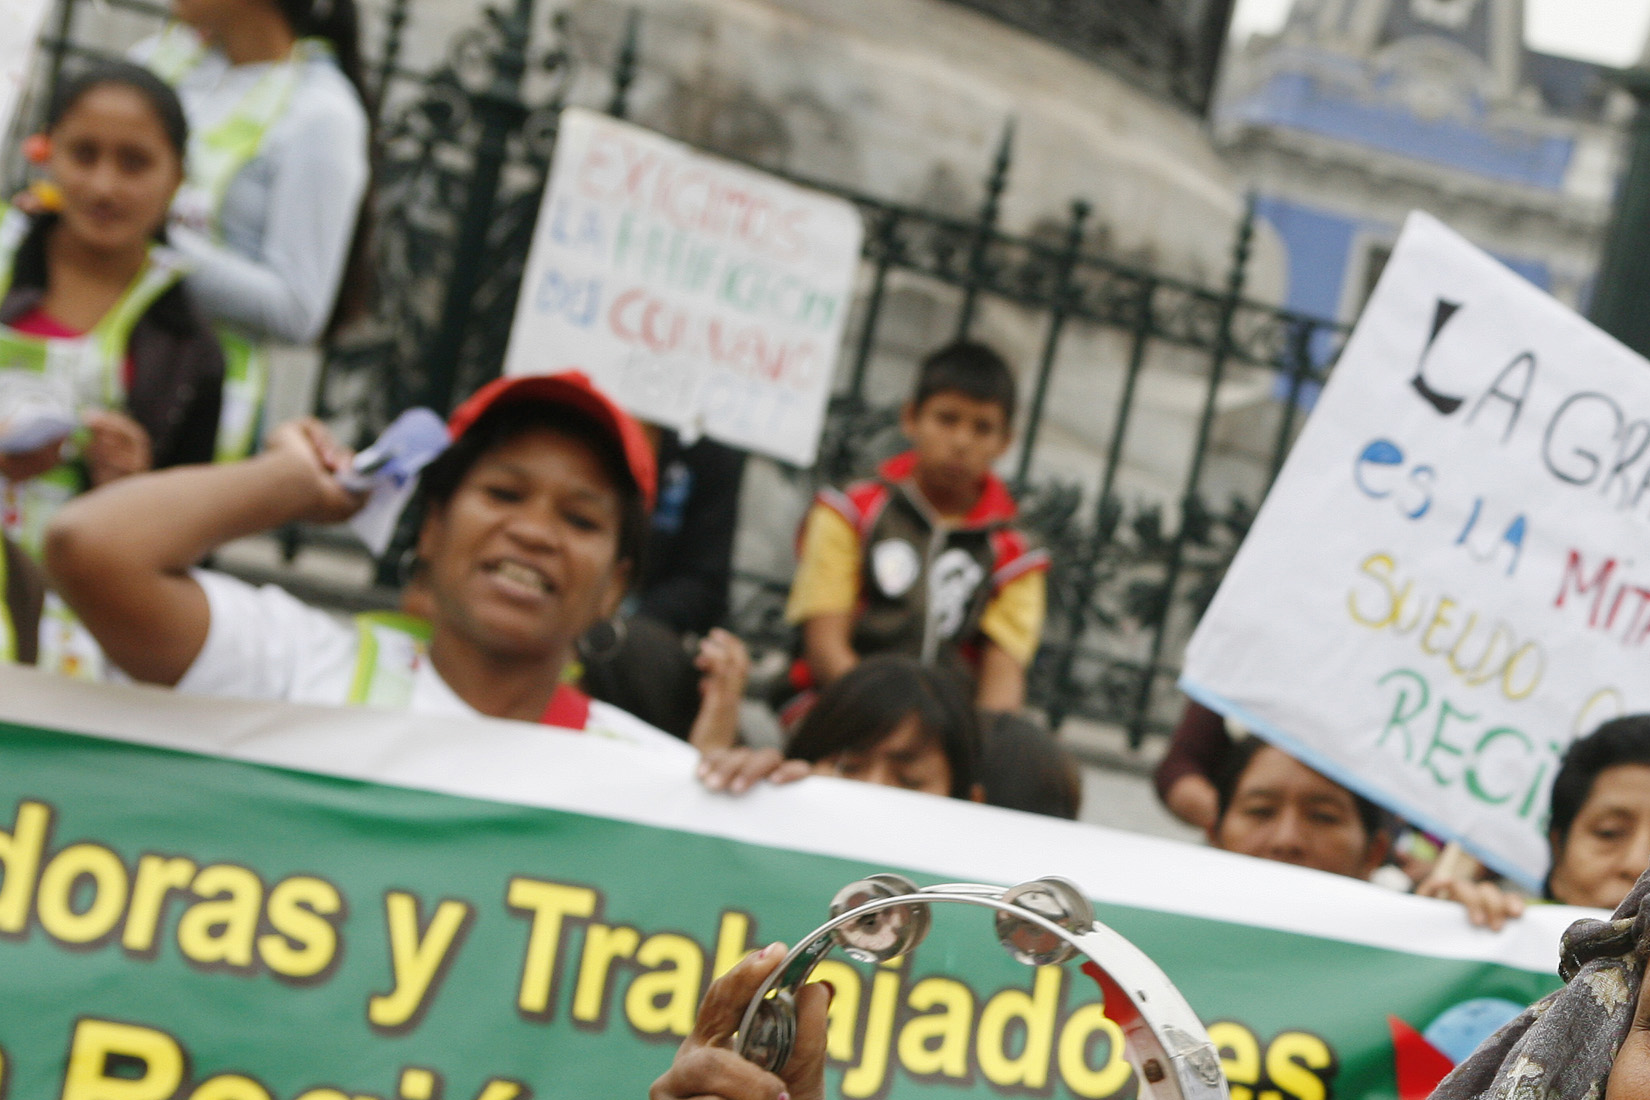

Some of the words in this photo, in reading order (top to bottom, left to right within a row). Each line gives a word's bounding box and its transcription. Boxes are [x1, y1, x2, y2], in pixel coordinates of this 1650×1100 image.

[1409, 299, 1539, 444] LA
[1348, 552, 1547, 702] SUELDO
[1376, 668, 1560, 838] RECI
[366, 890, 474, 1032] y
